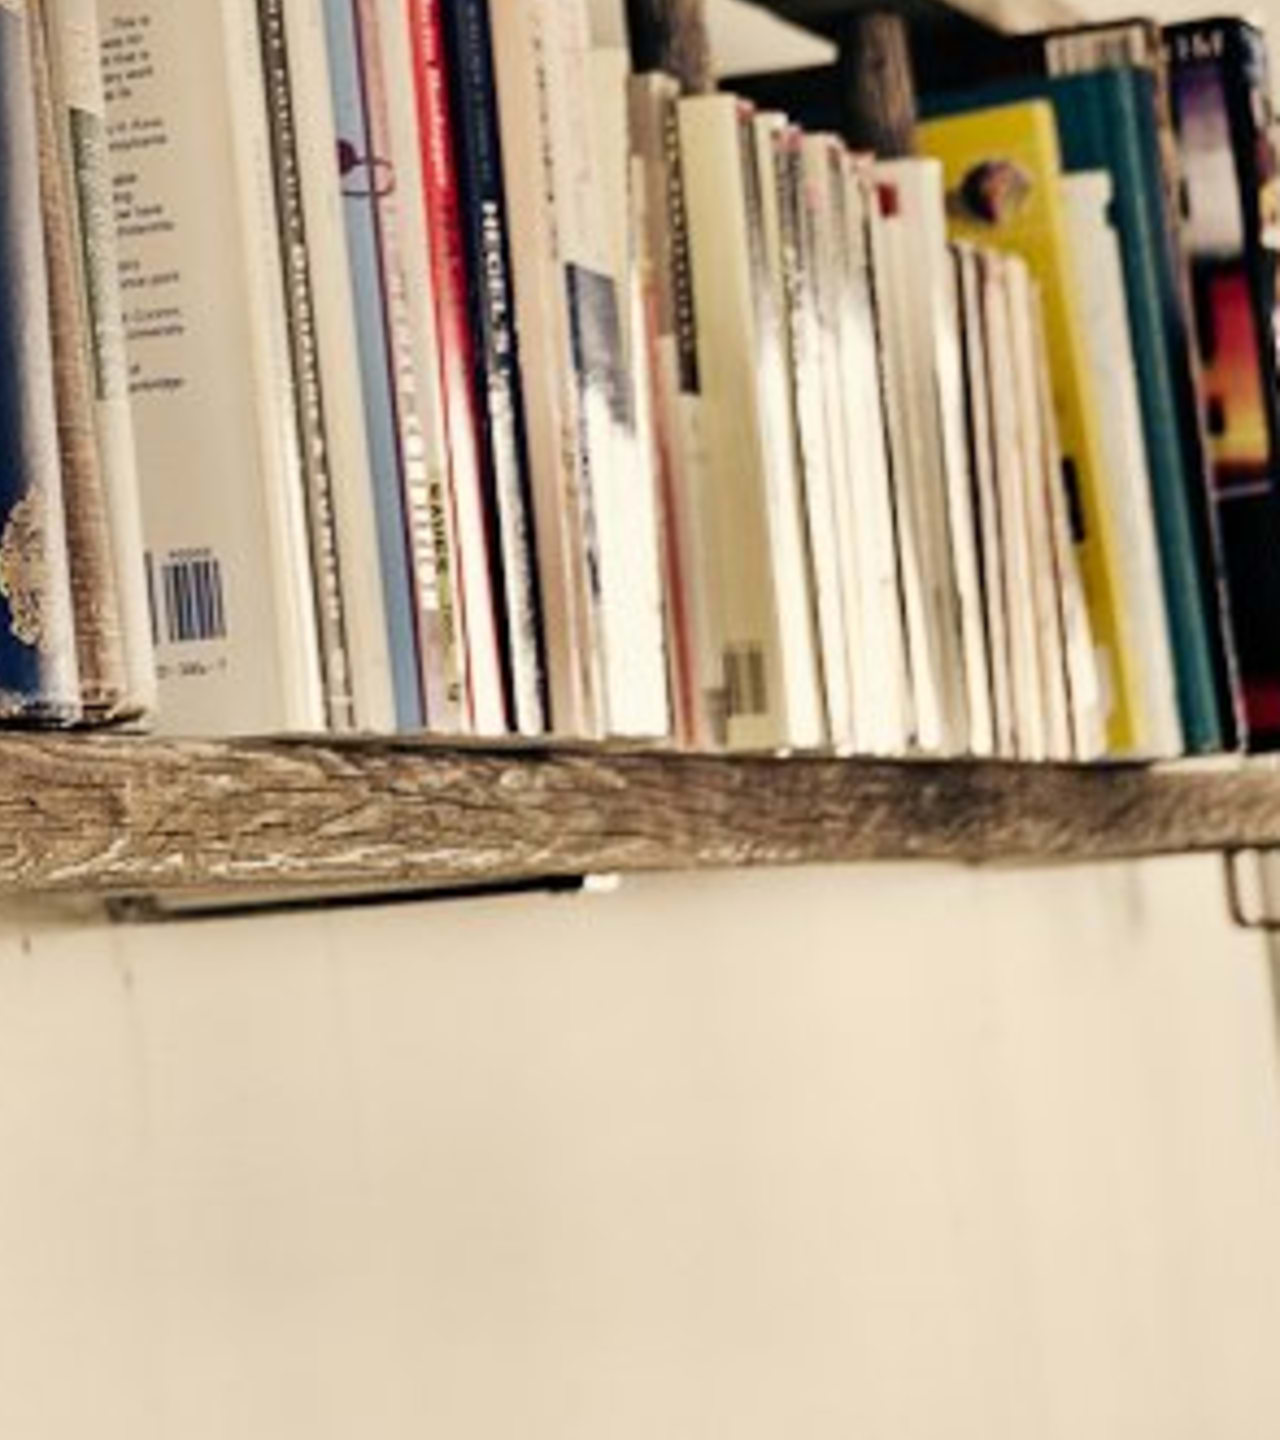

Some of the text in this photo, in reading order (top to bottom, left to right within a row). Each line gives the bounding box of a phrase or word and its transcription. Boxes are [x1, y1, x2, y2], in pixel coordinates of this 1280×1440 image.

[425, 66, 449, 189] Heidegger
[272, 67, 301, 229] FOUCAULT
[289, 242, 320, 422] DISCIPLINE
[313, 472, 341, 621] PUNISH
[403, 413, 438, 612] CONDITION
